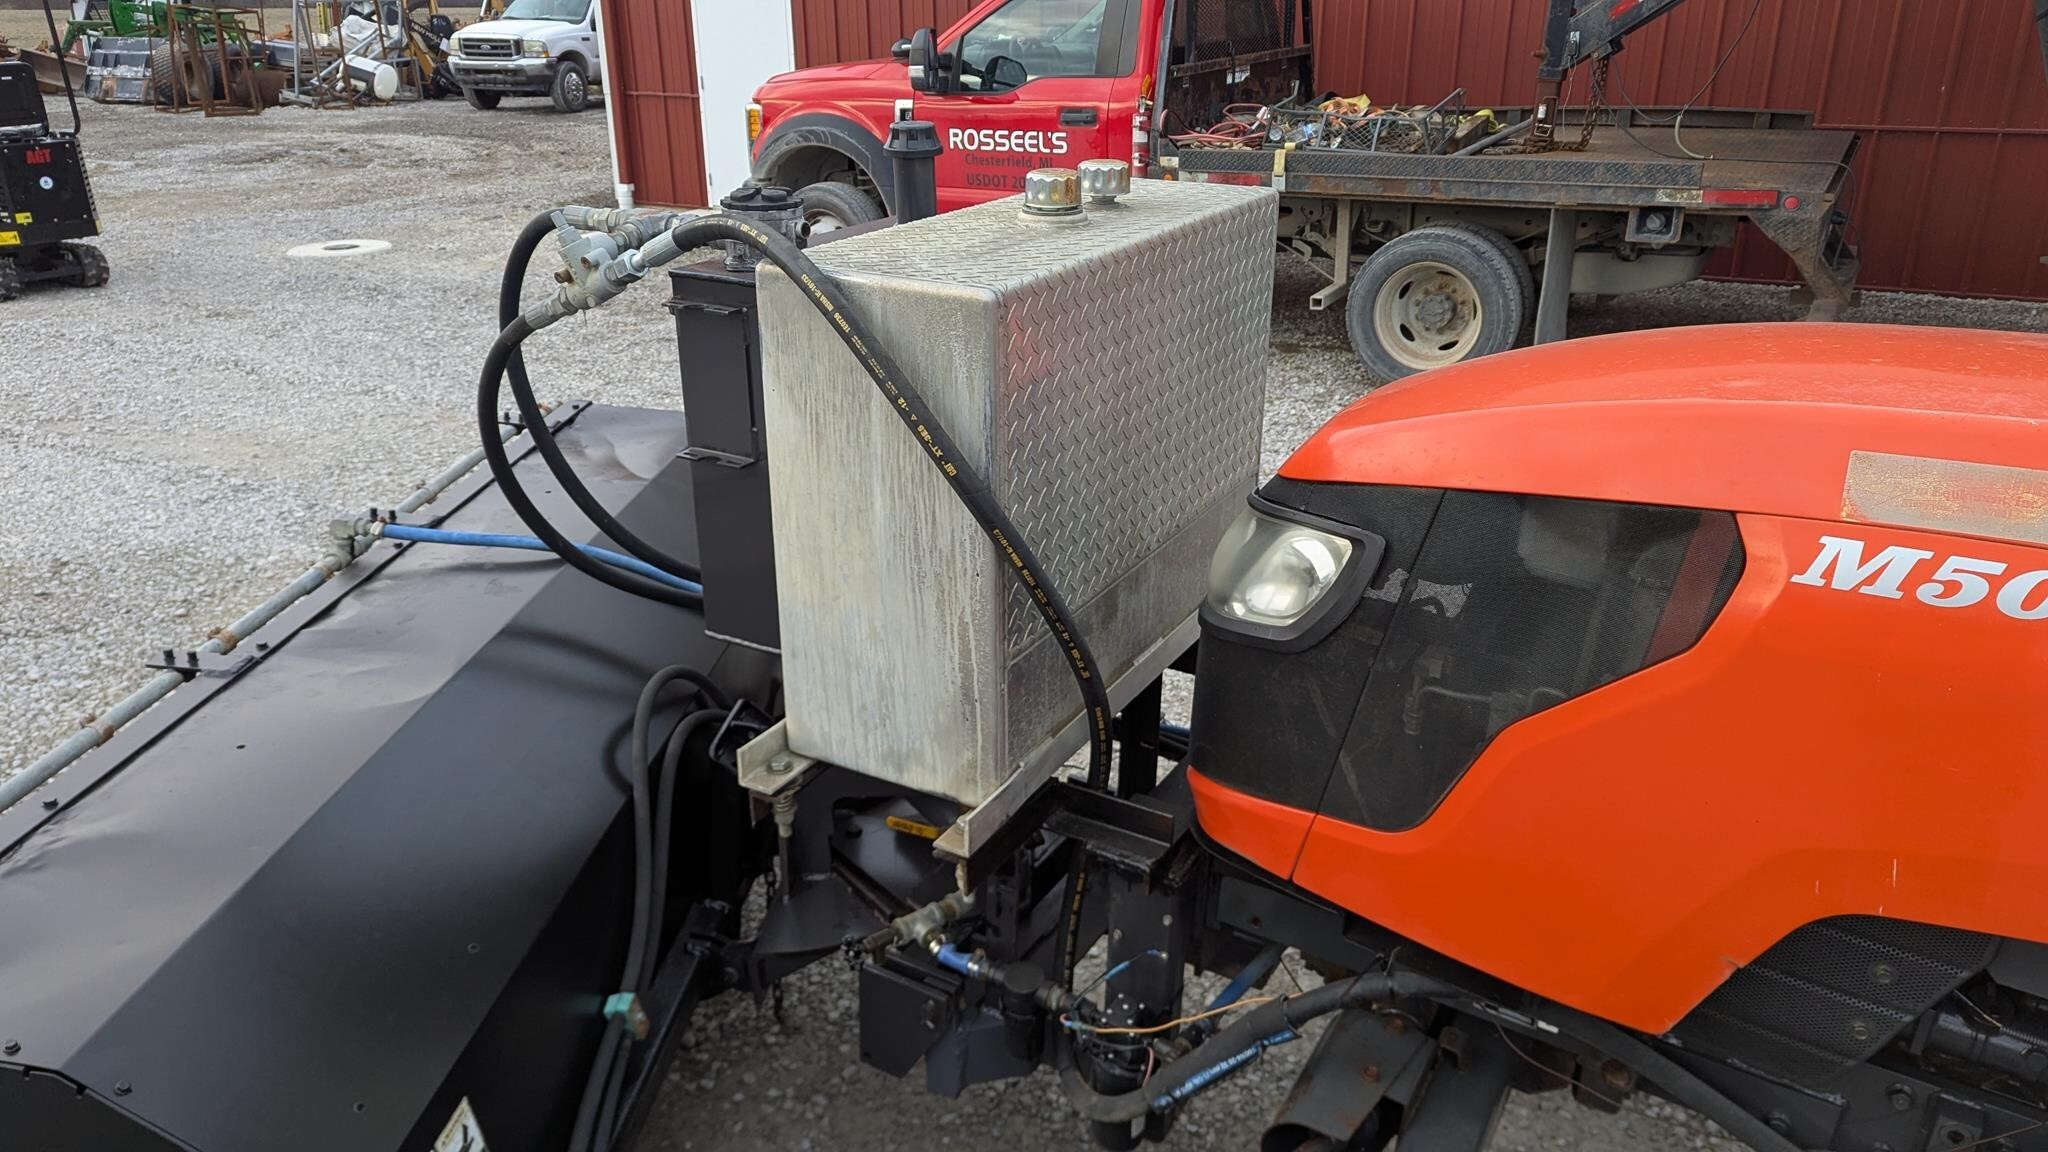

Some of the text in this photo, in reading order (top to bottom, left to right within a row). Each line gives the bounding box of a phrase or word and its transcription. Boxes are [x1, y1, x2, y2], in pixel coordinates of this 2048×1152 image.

[949, 128, 1068, 154] ROSSEEL'S
[26, 147, 52, 165] AGT
[964, 153, 1053, 169] Chesterfield, MI
[966, 172, 1008, 189] USDOT
[1790, 535, 2048, 621] M50
